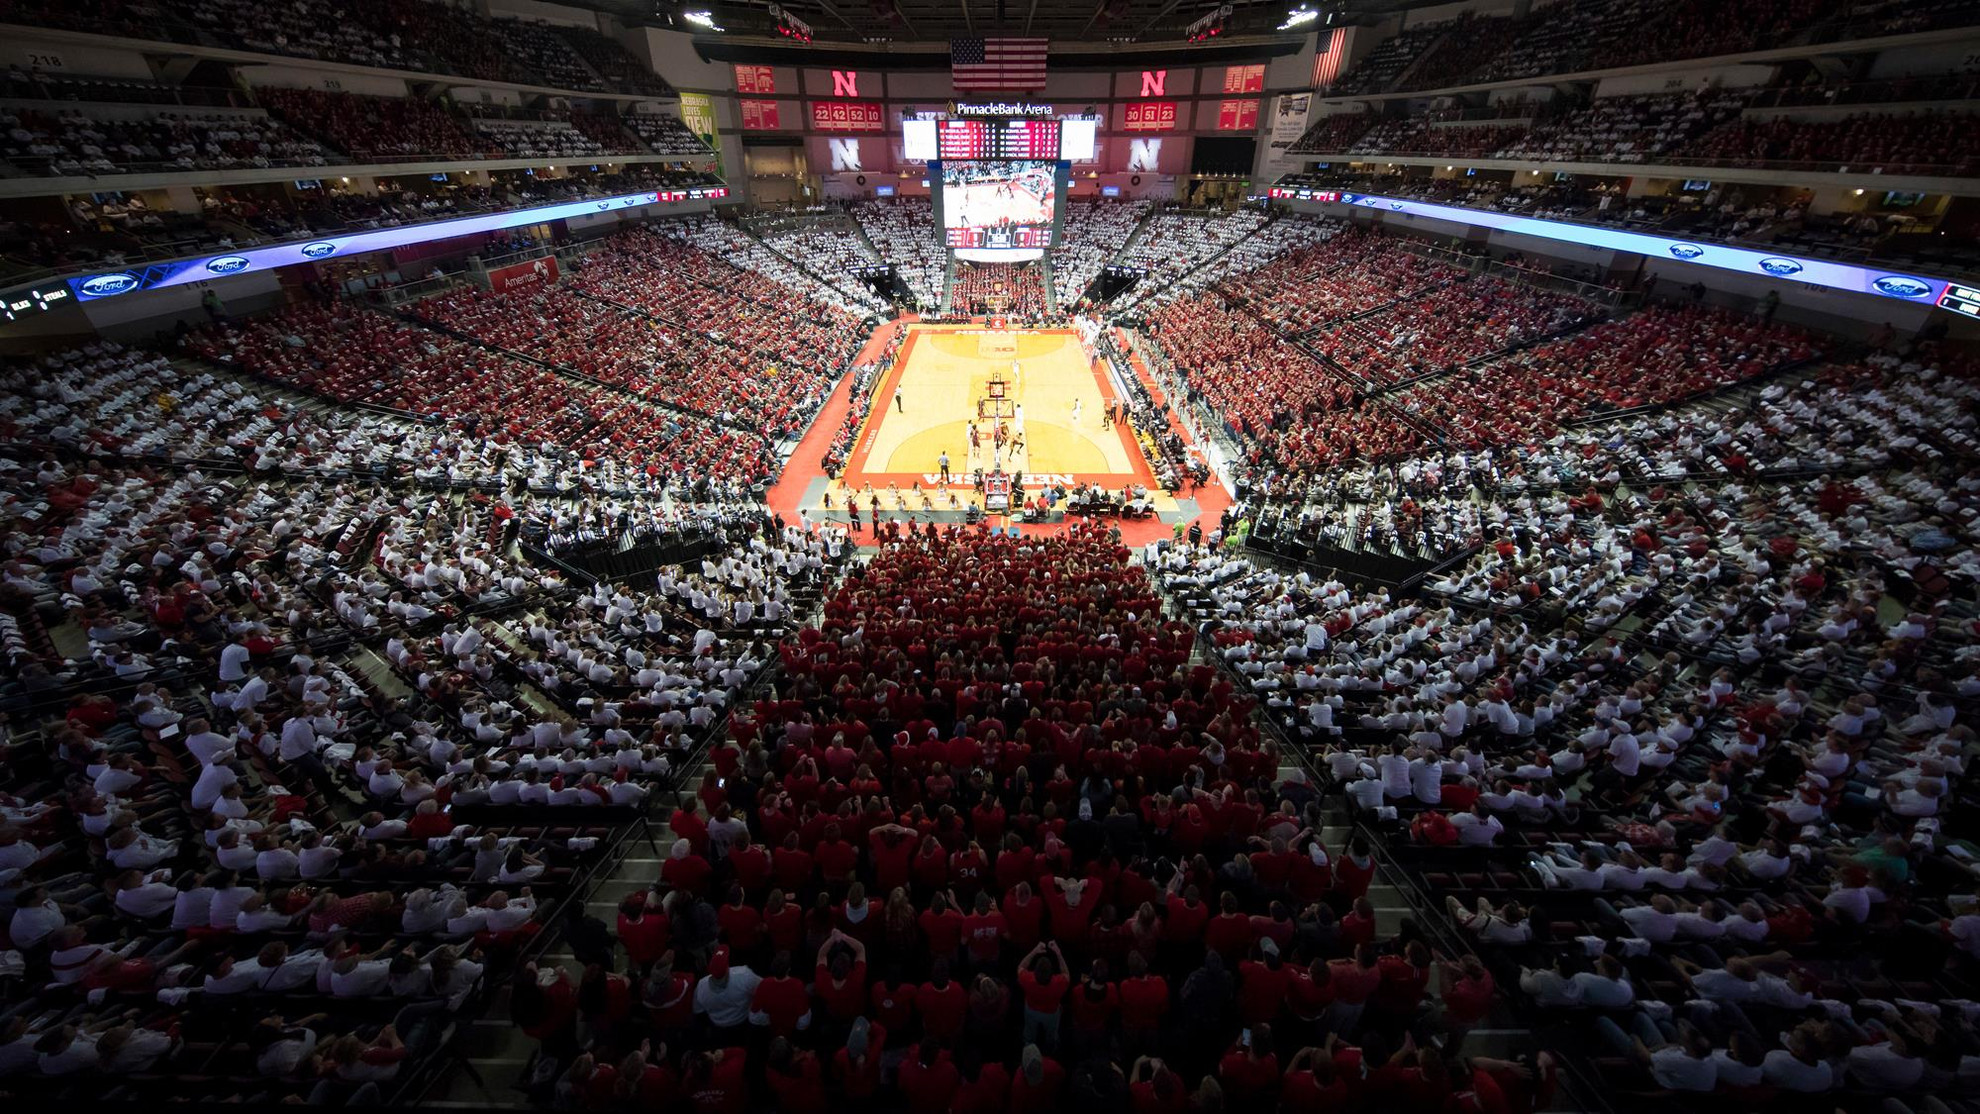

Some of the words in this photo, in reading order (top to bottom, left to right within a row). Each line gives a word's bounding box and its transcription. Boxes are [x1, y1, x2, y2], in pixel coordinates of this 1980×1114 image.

[28, 54, 62, 66] 218
[831, 70, 859, 97] N
[1140, 70, 1167, 97] N
[815, 109, 829, 120] 22
[832, 109, 846, 120] 42
[1024, 103, 1053, 115] Arena
[850, 110, 864, 121] 52
[868, 111, 879, 121] 10
[1127, 110, 1139, 121] 30
[1144, 110, 1155, 121] 51
[1161, 110, 1174, 120] 23
[828, 138, 862, 172] N
[1127, 138, 1162, 172] N
[505, 272, 538, 288] Ameritas
[922, 473, 1076, 486] NEBSKA
[959, 867, 977, 878] 34
